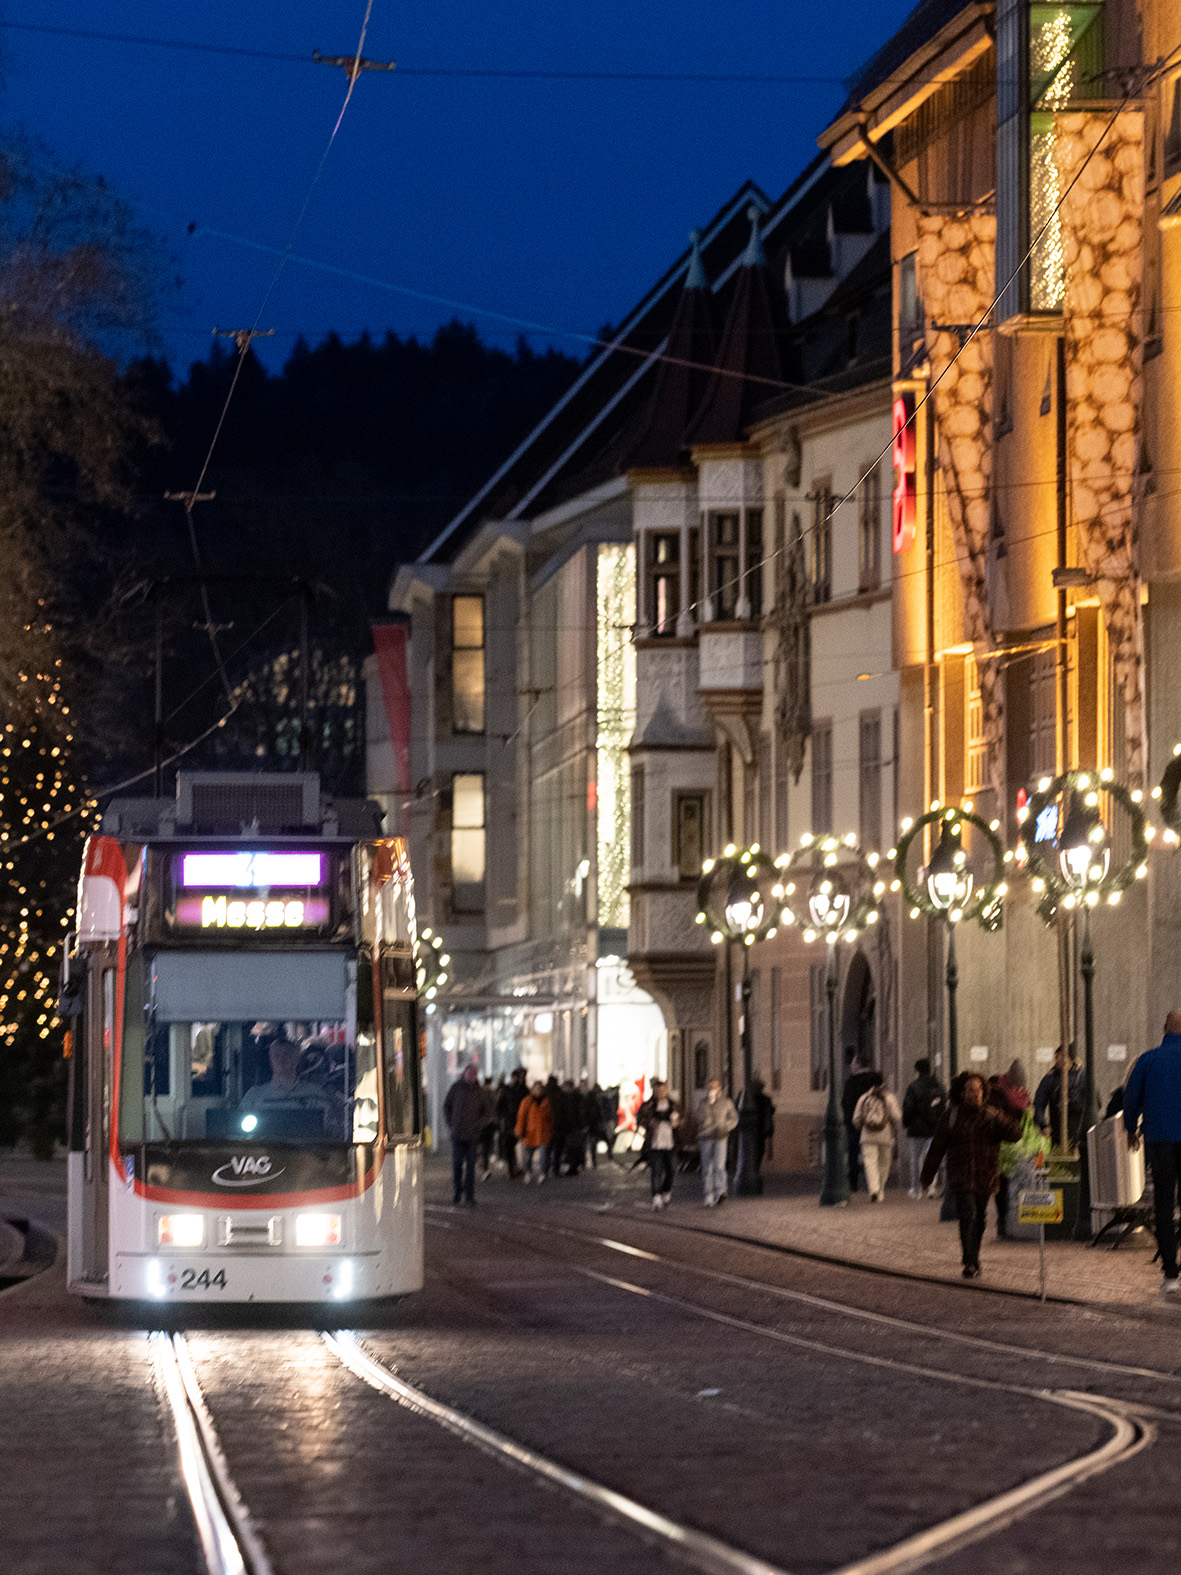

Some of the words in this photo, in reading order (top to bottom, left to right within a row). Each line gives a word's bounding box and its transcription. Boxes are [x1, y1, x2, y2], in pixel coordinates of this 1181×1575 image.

[201, 895, 305, 928] Messe
[230, 1155, 273, 1175] VAG
[180, 1267, 228, 1291] 244
